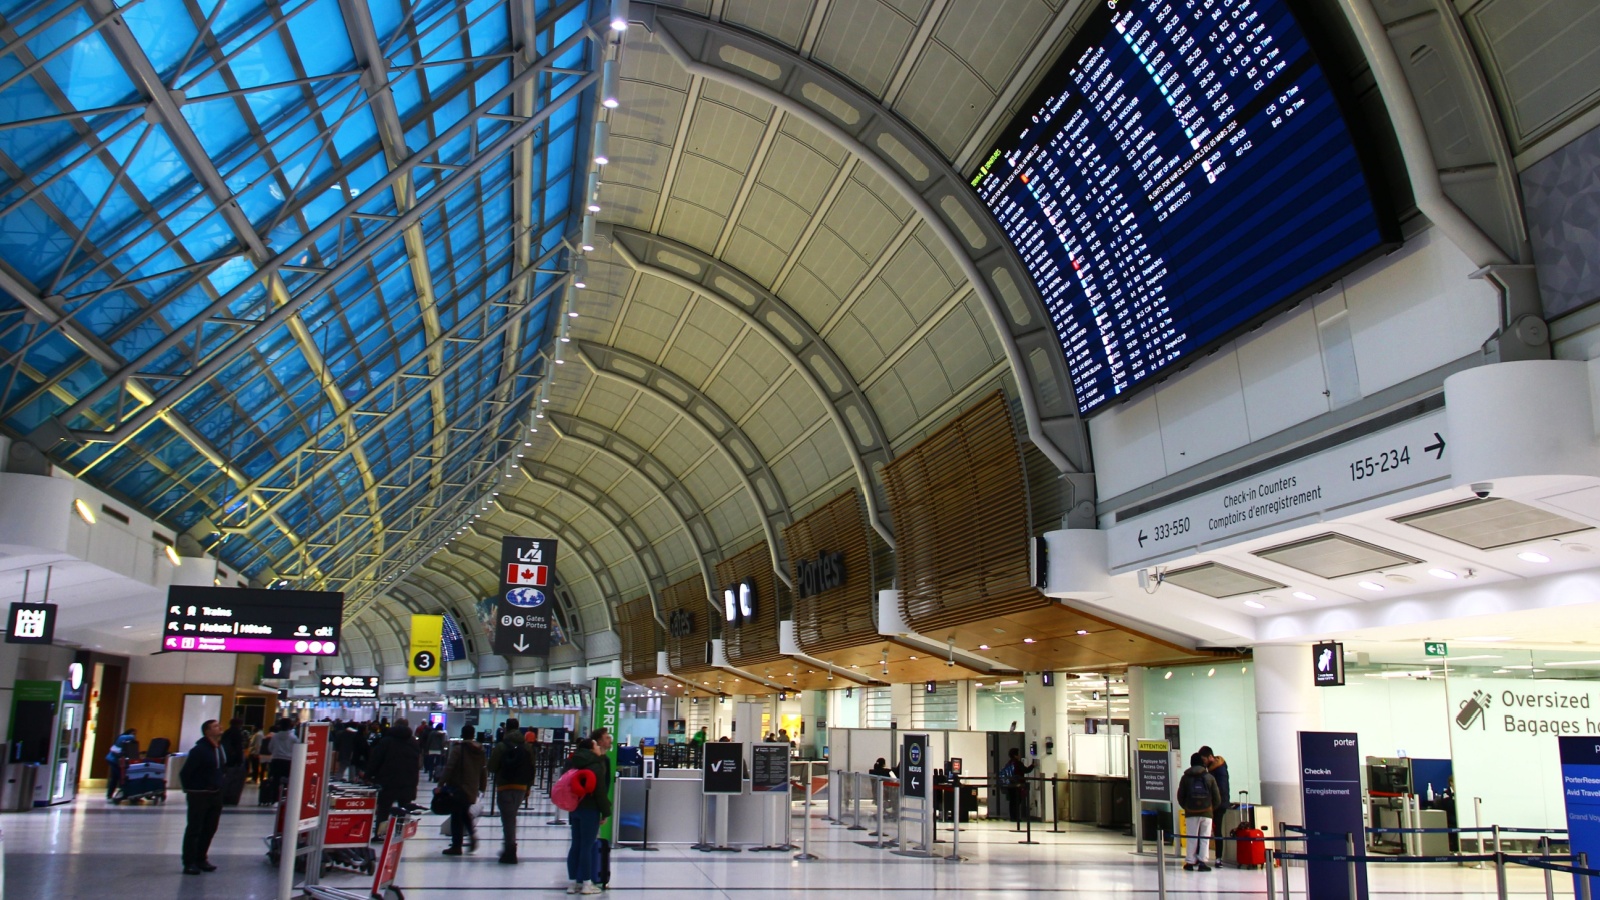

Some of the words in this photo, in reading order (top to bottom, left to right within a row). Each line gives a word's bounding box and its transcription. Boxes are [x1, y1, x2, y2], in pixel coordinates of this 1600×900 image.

[1238, 0, 1250, 11] Time
[1239, 22, 1247, 30] On
[1245, 11, 1258, 23] Time
[1246, 34, 1255, 42] On
[1252, 23, 1265, 35] Time
[1091, 59, 1110, 82] SASKATOON
[1267, 70, 1275, 78] On
[1273, 60, 1286, 72] Time
[1098, 72, 1113, 91] CALGARY
[1118, 97, 1138, 120] VANCOUVER
[1143, 145, 1157, 160] OTTAWA
[1253, 46, 1262, 54] On
[1260, 36, 1272, 48] Time
[1148, 156, 1163, 170] OTTAWA
[1260, 58, 1268, 66] On
[1266, 48, 1280, 60] Time
[1164, 190, 1176, 203] HONG
[1174, 181, 1186, 194] KONG
[1279, 95, 1288, 104] On
[1286, 86, 1299, 98] Time
[1169, 198, 1183, 213] MEXICO
[1182, 191, 1192, 202] CITY
[1285, 108, 1294, 116] On
[1292, 99, 1305, 110] Time
[1148, 184, 1163, 201] FLIGHTS
[1162, 179, 1171, 189] FOR
[1169, 171, 1179, 182] MAR
[1203, 144, 1211, 153] DU
[1215, 129, 1228, 144] MARS
[1349, 446, 1411, 481] 155-234
[1223, 488, 1256, 509] Check-in
[1258, 475, 1297, 498] Counters
[1208, 509, 1246, 531] Comptoirs
[1248, 485, 1322, 520] d'enregistrement
[1154, 516, 1191, 542] 333-550
[796, 550, 844, 597] Portes
[202, 607, 232, 616] Trains
[669, 608, 692, 638] Gates
[200, 623, 232, 633] Hotels
[419, 654, 430, 668] 3
[1502, 690, 1590, 708] Oversized
[1504, 715, 1580, 736] Bagages
[1334, 738, 1355, 747] porter
